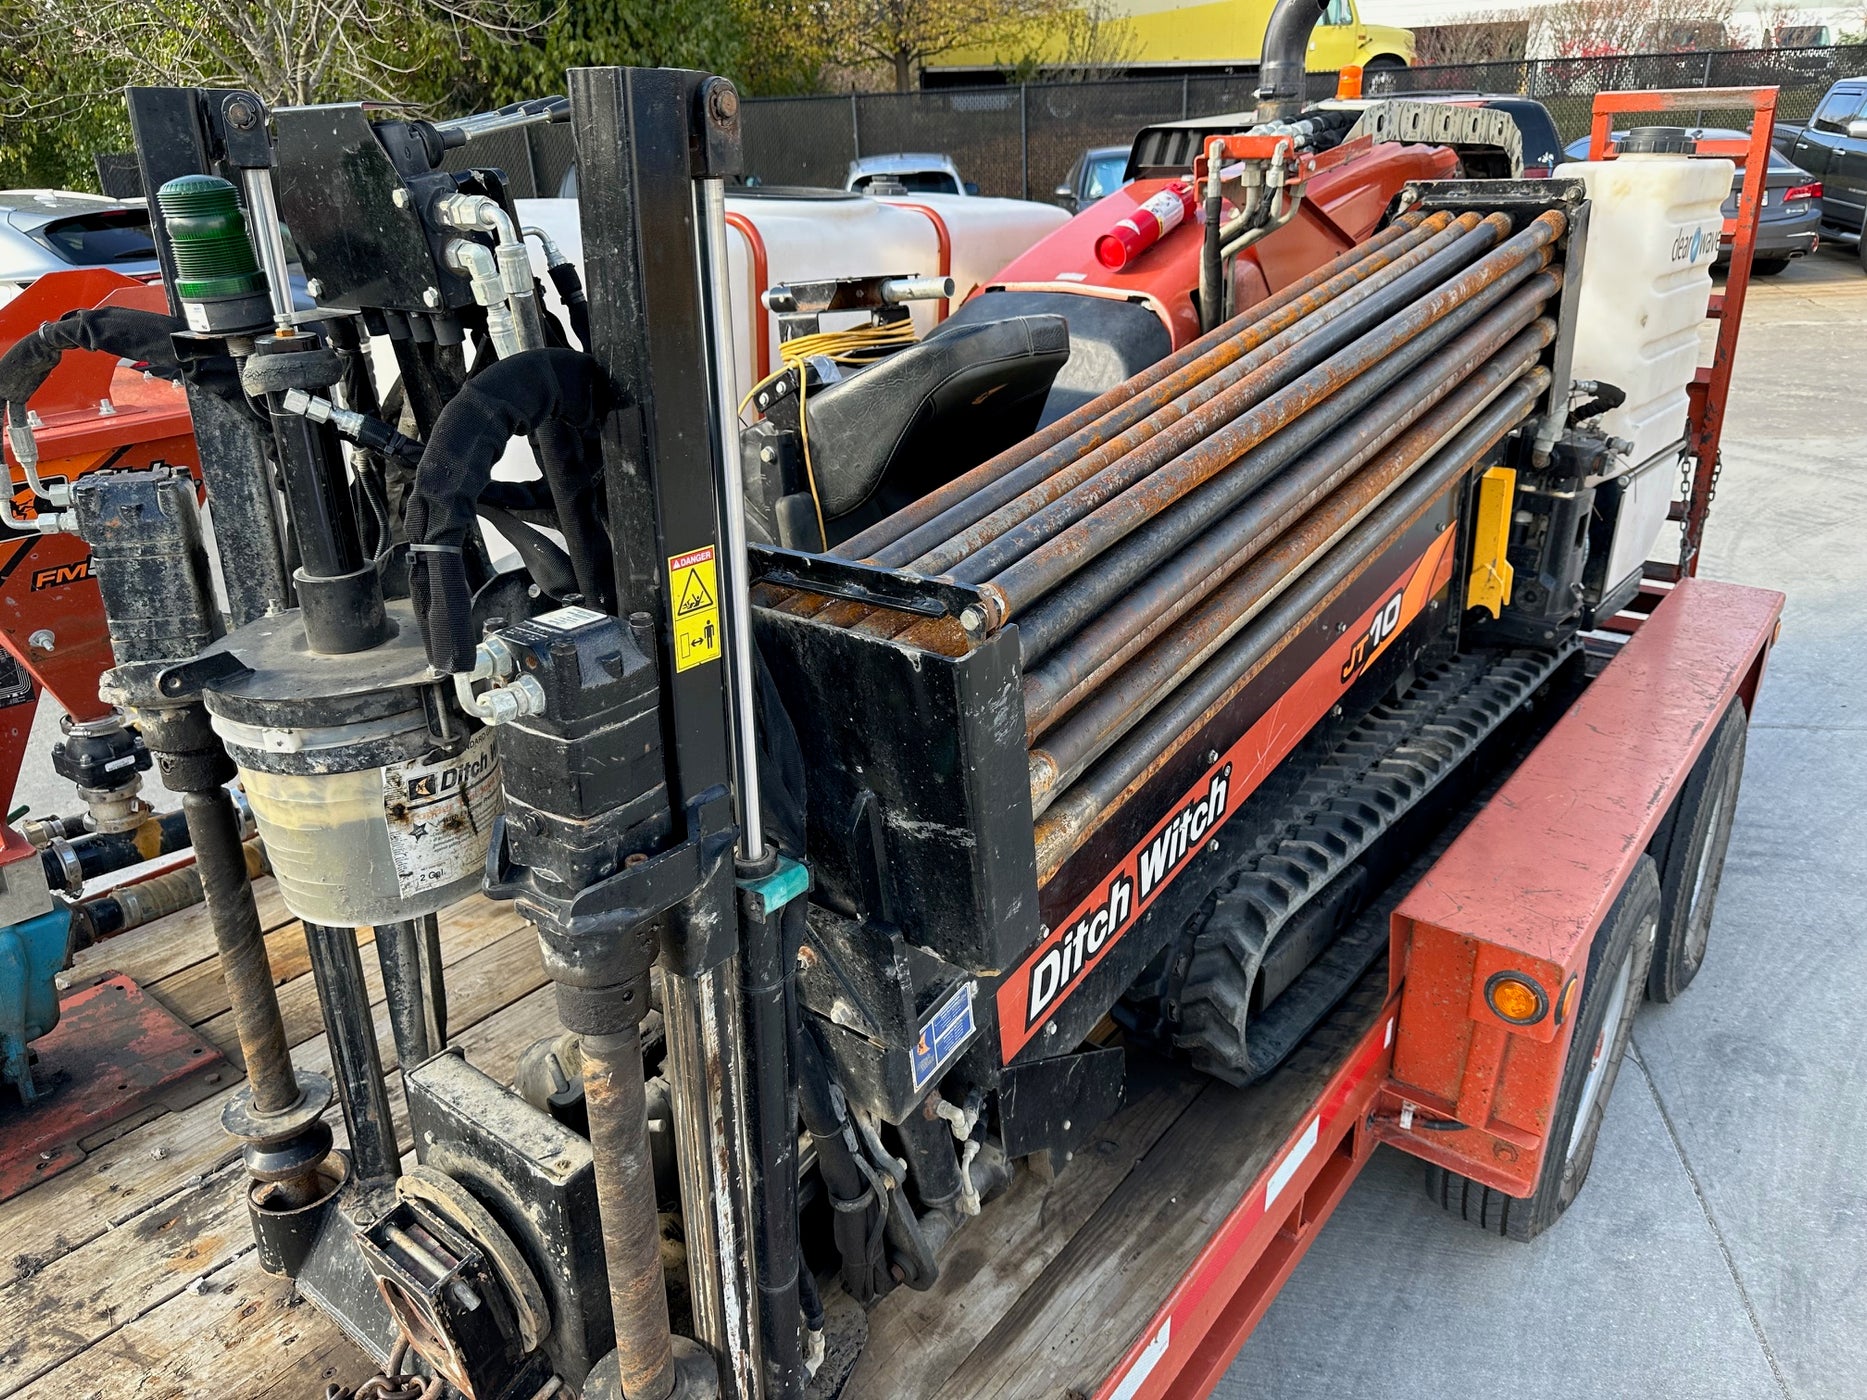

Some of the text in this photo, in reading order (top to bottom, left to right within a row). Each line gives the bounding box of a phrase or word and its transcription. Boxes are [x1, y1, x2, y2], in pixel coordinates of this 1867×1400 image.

[680, 551, 711, 567] DANGER
[440, 751, 488, 791] Ditch
[420, 874, 426, 882] 2
[1030, 880, 1130, 1022] Ditch
